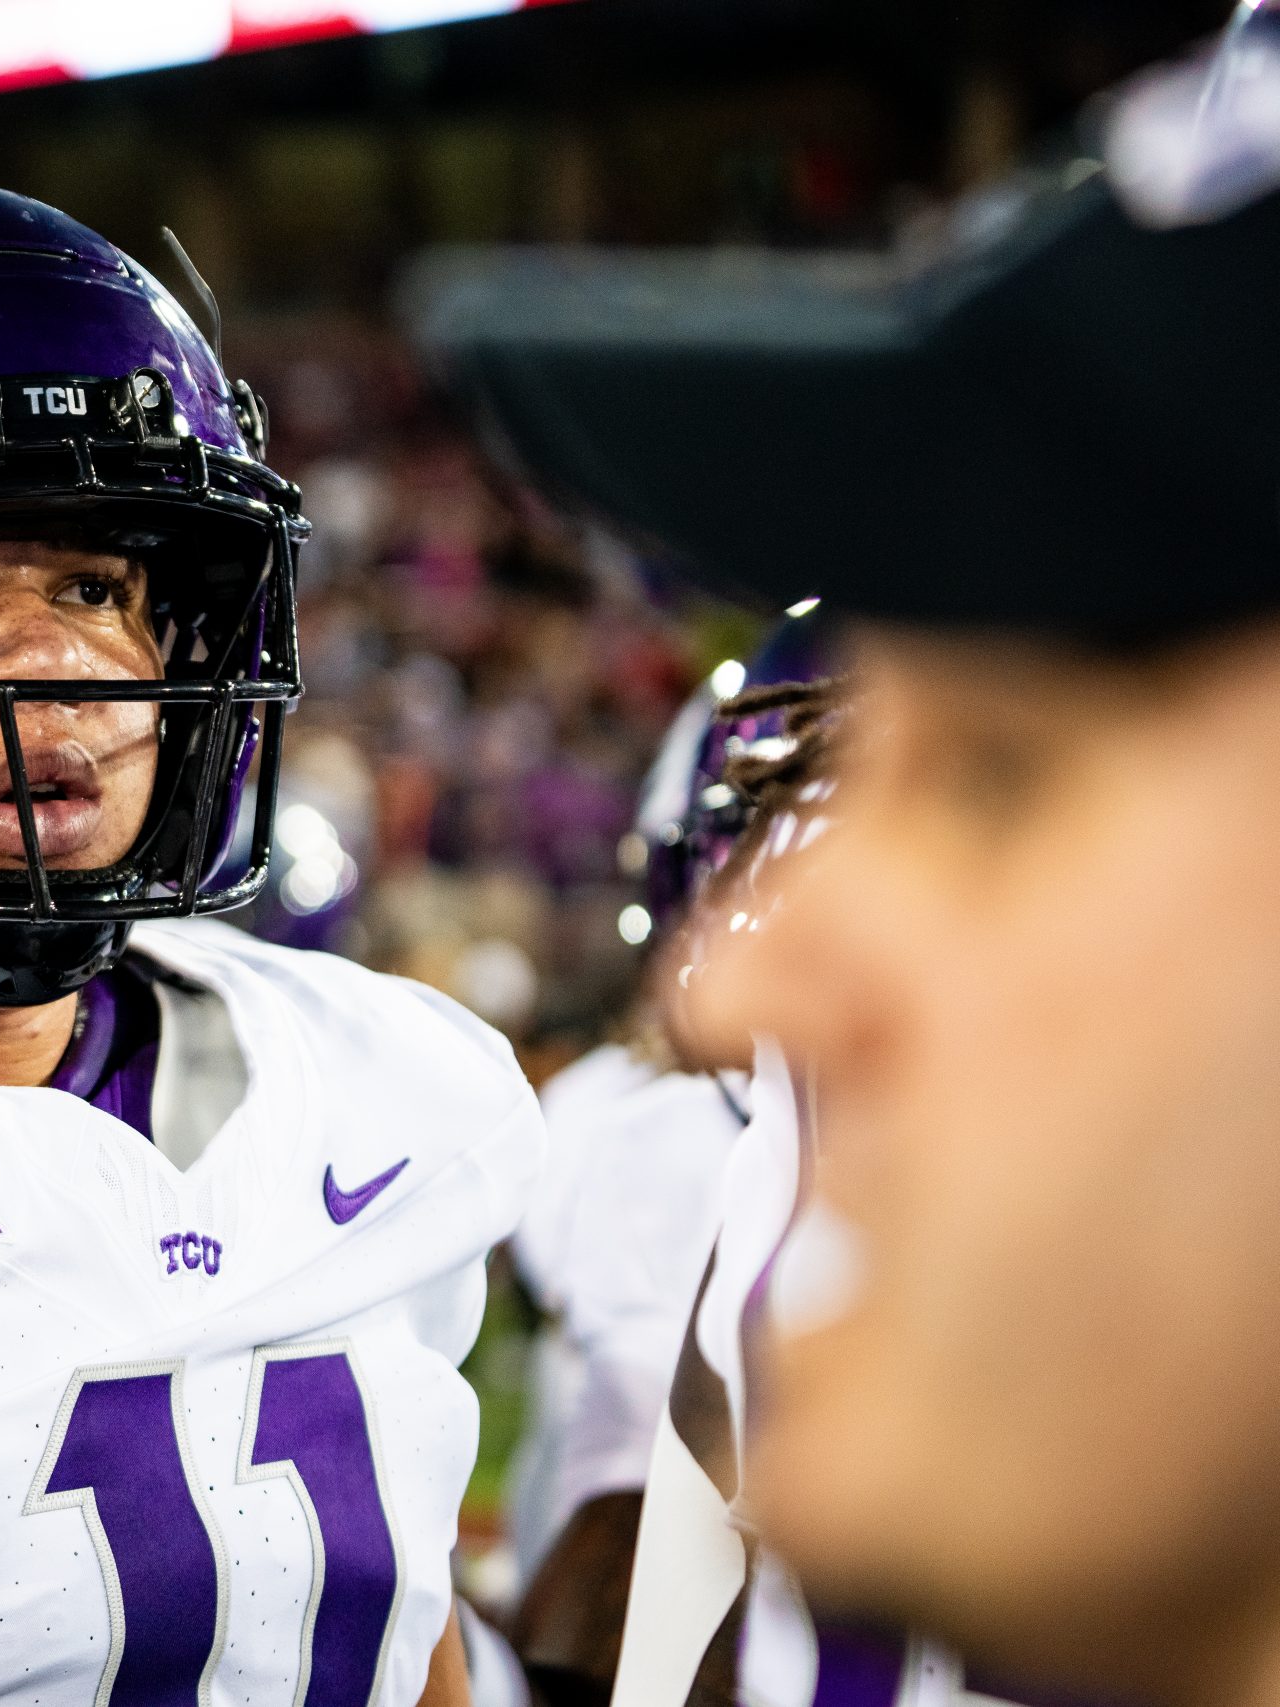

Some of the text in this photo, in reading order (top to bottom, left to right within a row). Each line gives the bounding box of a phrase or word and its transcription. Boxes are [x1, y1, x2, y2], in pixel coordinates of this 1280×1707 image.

[22, 386, 88, 416] TCU
[159, 1231, 223, 1277] TCU
[20, 1336, 408, 1707] 11
